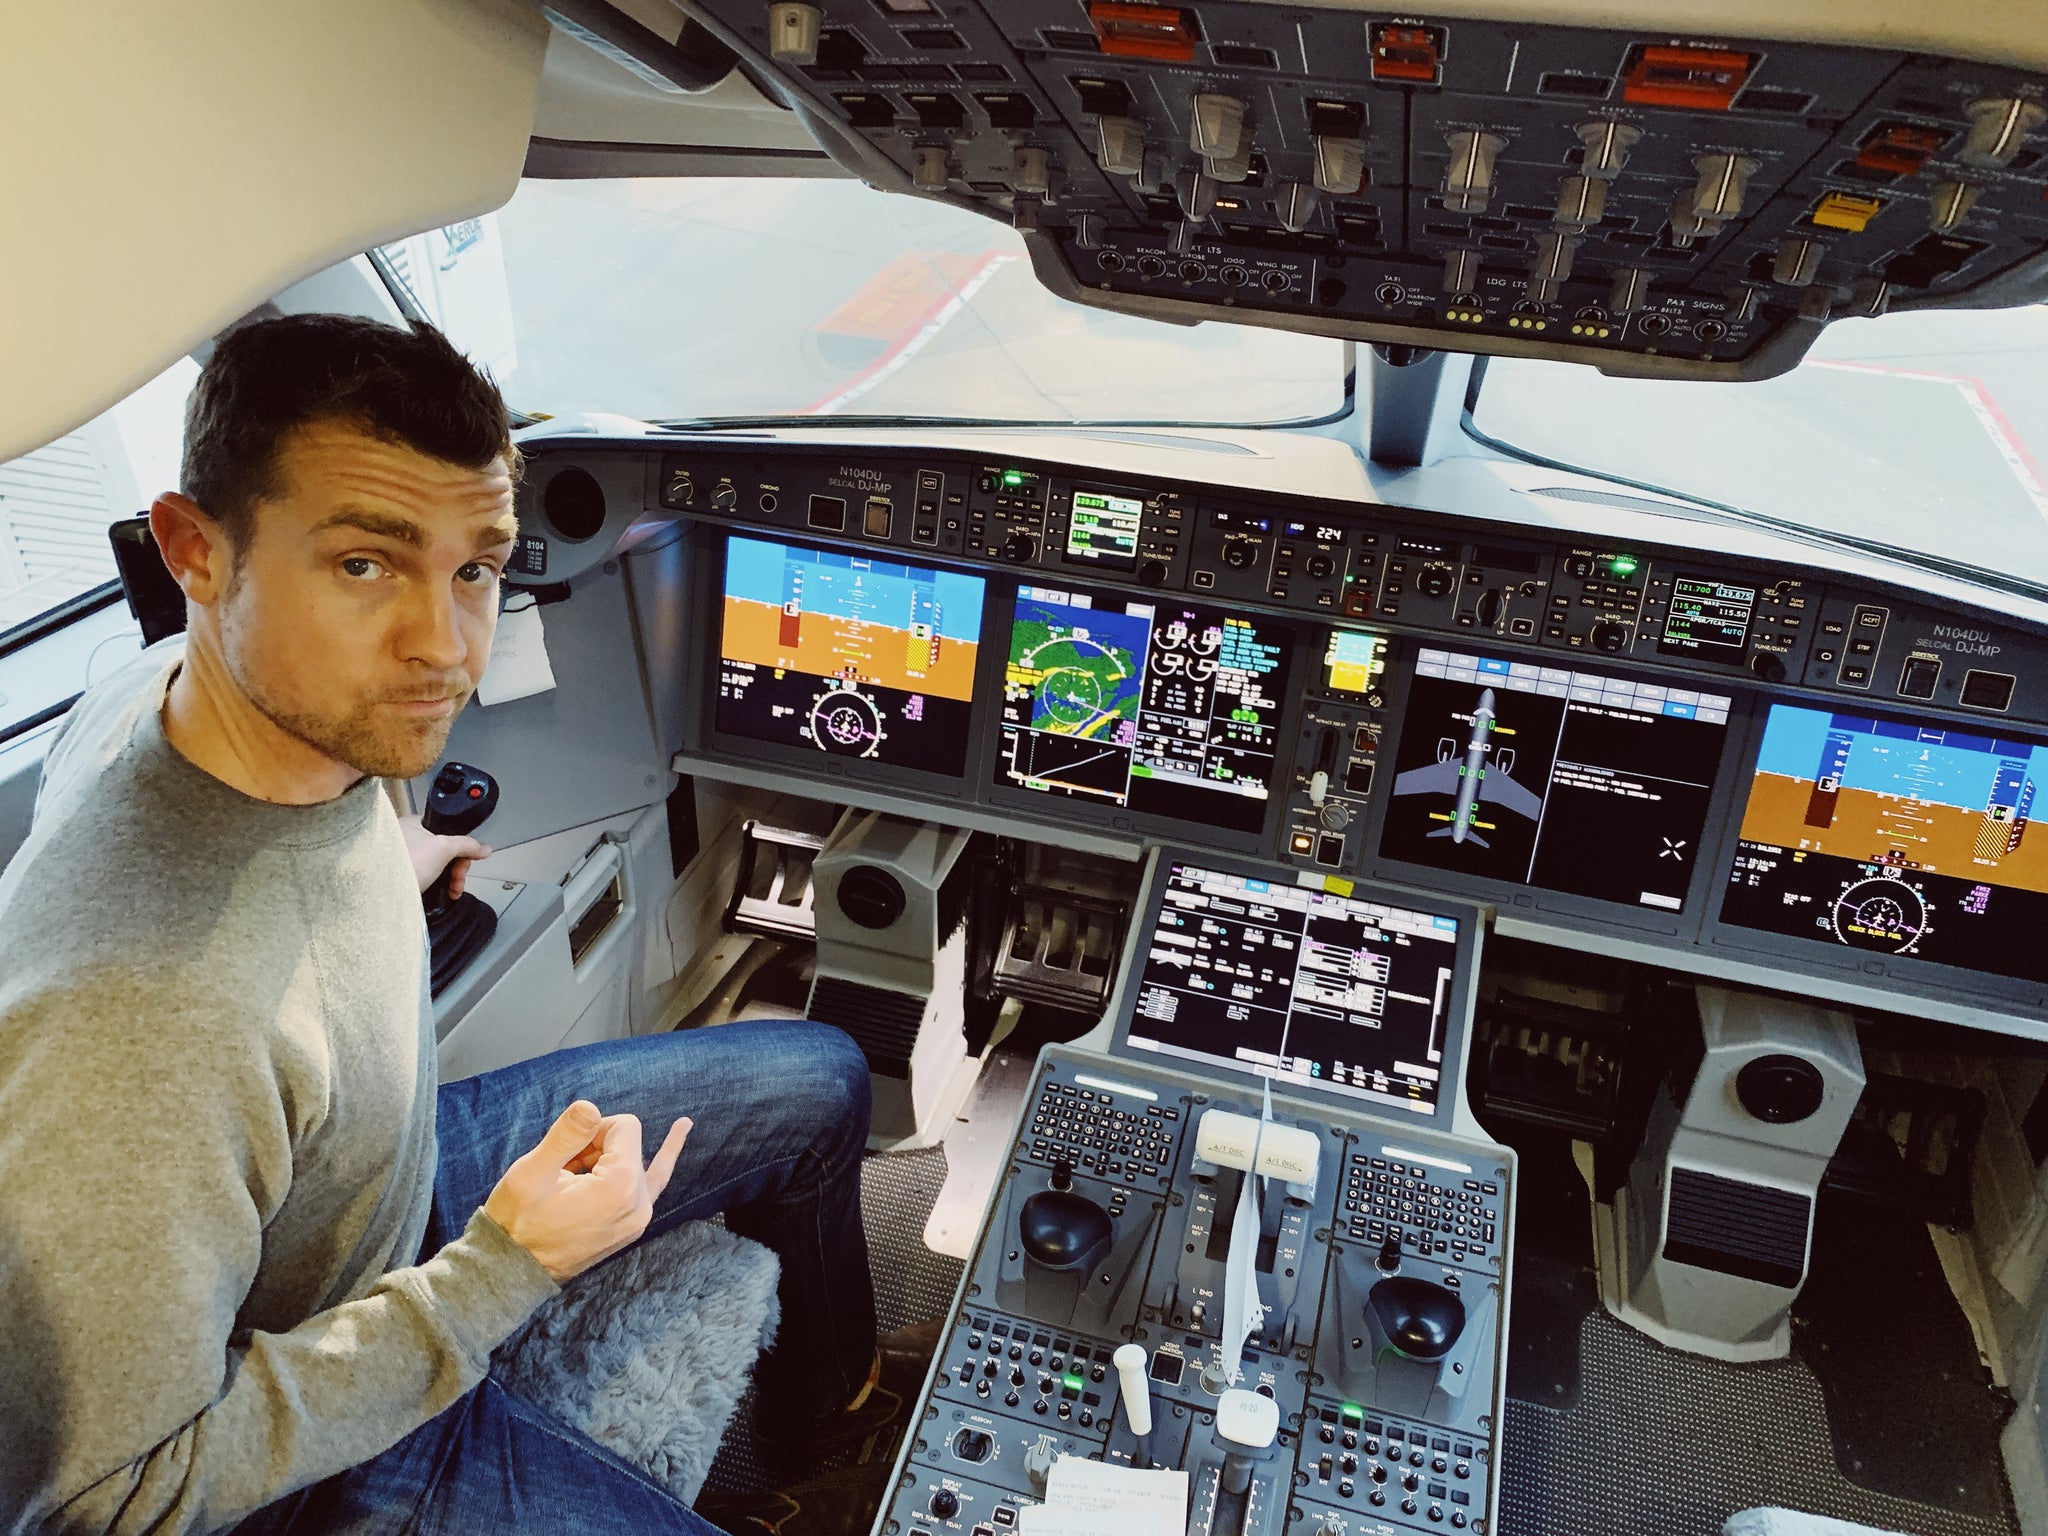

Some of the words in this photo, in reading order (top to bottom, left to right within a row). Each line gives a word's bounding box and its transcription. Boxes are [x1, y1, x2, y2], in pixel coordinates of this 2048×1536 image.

[1137, 248, 1166, 257] BEACON
[1223, 257, 1245, 266] LOGO
[1487, 278, 1506, 286] LDG
[1407, 294, 1435, 302] NARROW
[1692, 302, 1725, 310] SIGNS
[840, 466, 882, 482] N104DU
[858, 479, 892, 493] DJ-MP
[1317, 527, 1341, 540] 224
[527, 540, 544, 551] 8104
[1572, 549, 1592, 557] RANGE
[1679, 584, 1712, 594] 121.700
[1674, 602, 1702, 612] 115.40
[1719, 609, 1747, 618] 115.50
[1671, 620, 1690, 628] 1144
[1722, 628, 1743, 637] AUTO
[1933, 625, 1990, 644] N104DU
[1683, 640, 1700, 648] PAGE
[1755, 644, 1787, 653] TUNE/DATA
[1955, 641, 2001, 656] DJ-MP
[1517, 668, 1532, 676] ELEC
[1199, 1288, 1213, 1297] ENG
[1196, 1300, 1205, 1308] ON
[970, 1415, 992, 1426] AILERON
